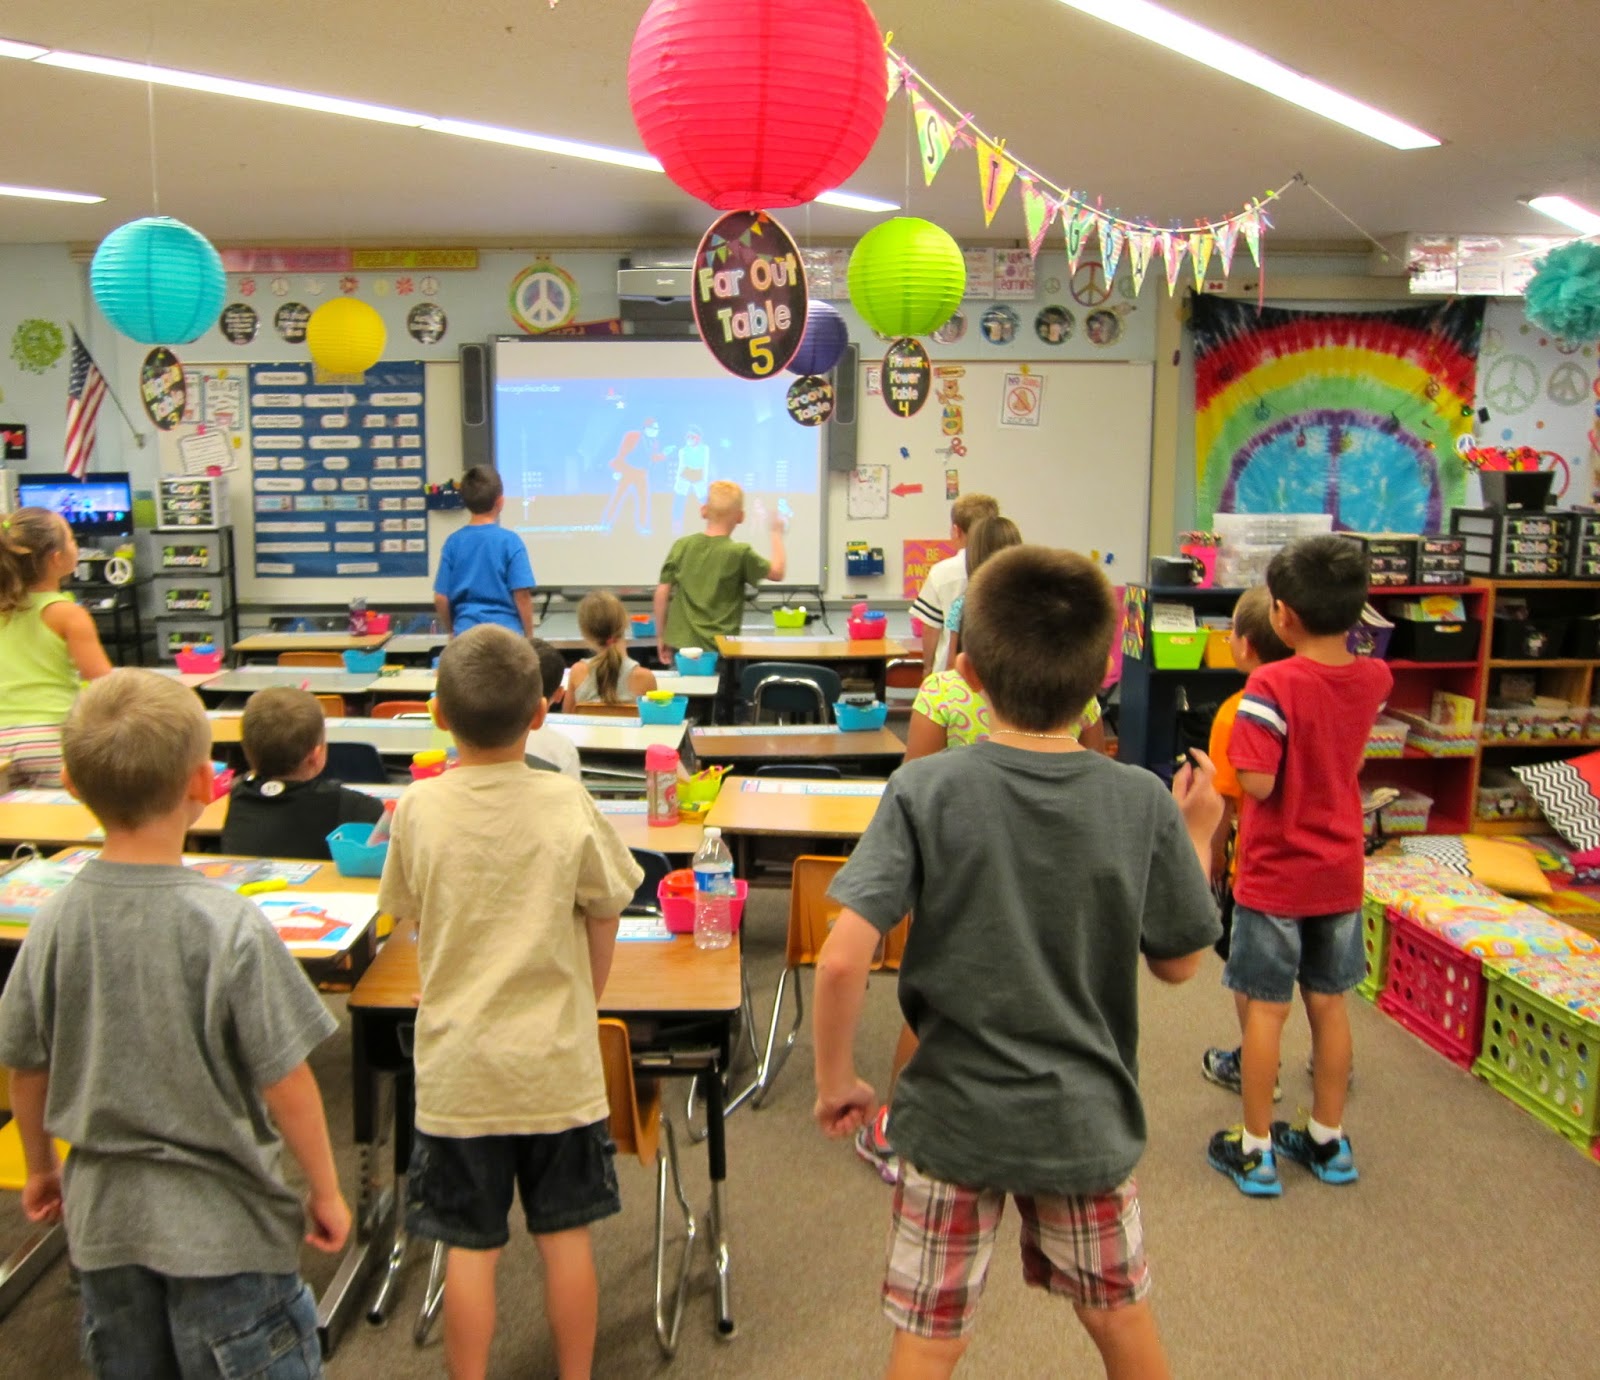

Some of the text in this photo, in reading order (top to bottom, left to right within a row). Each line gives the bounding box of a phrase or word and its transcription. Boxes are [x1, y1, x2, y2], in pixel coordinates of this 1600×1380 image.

[699, 266, 745, 303] Far
[751, 251, 798, 291] Out
[717, 299, 792, 344] Table
[749, 335, 775, 375] 5
[888, 353, 923, 368] Flower
[889, 370, 921, 385] Power
[787, 385, 832, 410] Groovy
[891, 386, 920, 401] Table
[795, 401, 831, 422] Table
[899, 400, 910, 418] 4
[812, 414, 822, 425] 2
[1512, 519, 1558, 536] Table 1
[1511, 539, 1558, 554] Table 2
[163, 555, 209, 568] Monday
[1510, 558, 1558, 574] Table 3
[167, 599, 213, 612] Tuesday
